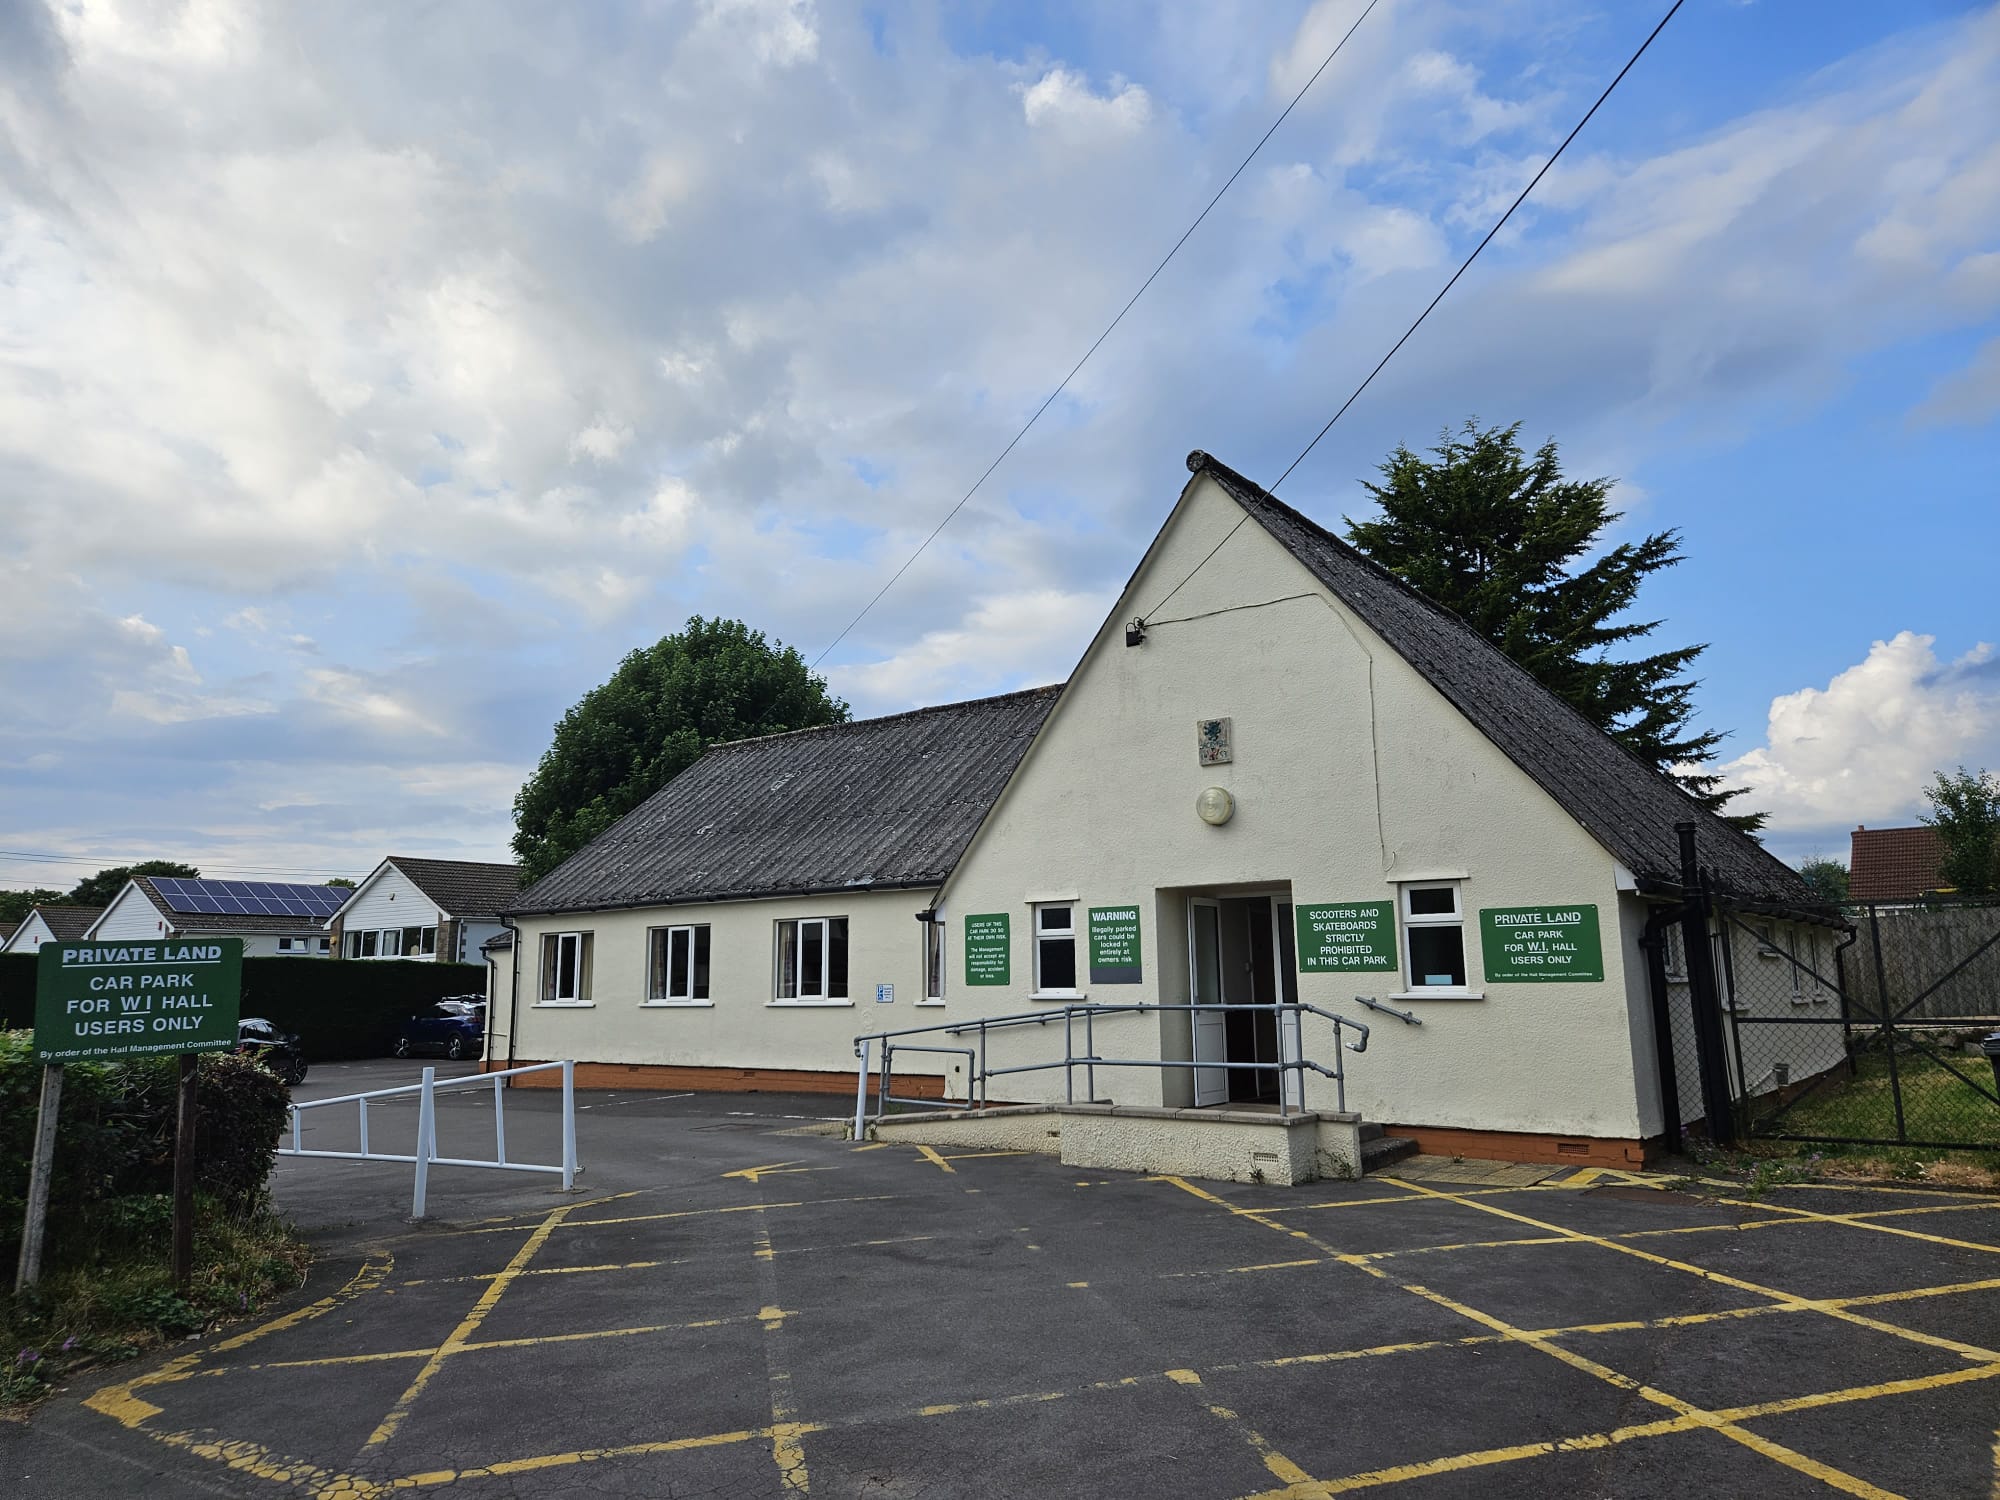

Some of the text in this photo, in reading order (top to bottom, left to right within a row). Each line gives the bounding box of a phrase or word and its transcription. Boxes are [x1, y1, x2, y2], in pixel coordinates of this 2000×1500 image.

[1092, 911, 1136, 921] WARNING
[1310, 909, 1378, 919] SCOOTERS AND
[1495, 912, 1581, 924] PRIVATE LAND
[1313, 921, 1376, 931] SKATEBOARDS
[1326, 934, 1364, 942] STRICTLY
[1321, 946, 1372, 954] PROHIBITED
[1527, 942, 1548, 951] W.I.
[62, 946, 222, 963] PRIVATE LAND
[1319, 957, 1338, 966] THIS
[1342, 957, 1360, 965] CAR
[1364, 956, 1387, 964] PARK
[90, 974, 194, 991] CAR PARK
[67, 999, 110, 1014] FOR
[162, 994, 213, 1009] HALL
[75, 1016, 203, 1036] USERS ONLY
[40, 1051, 53, 1059] By
[130, 1042, 185, 1052] Management
[187, 1039, 231, 1048] Committee
